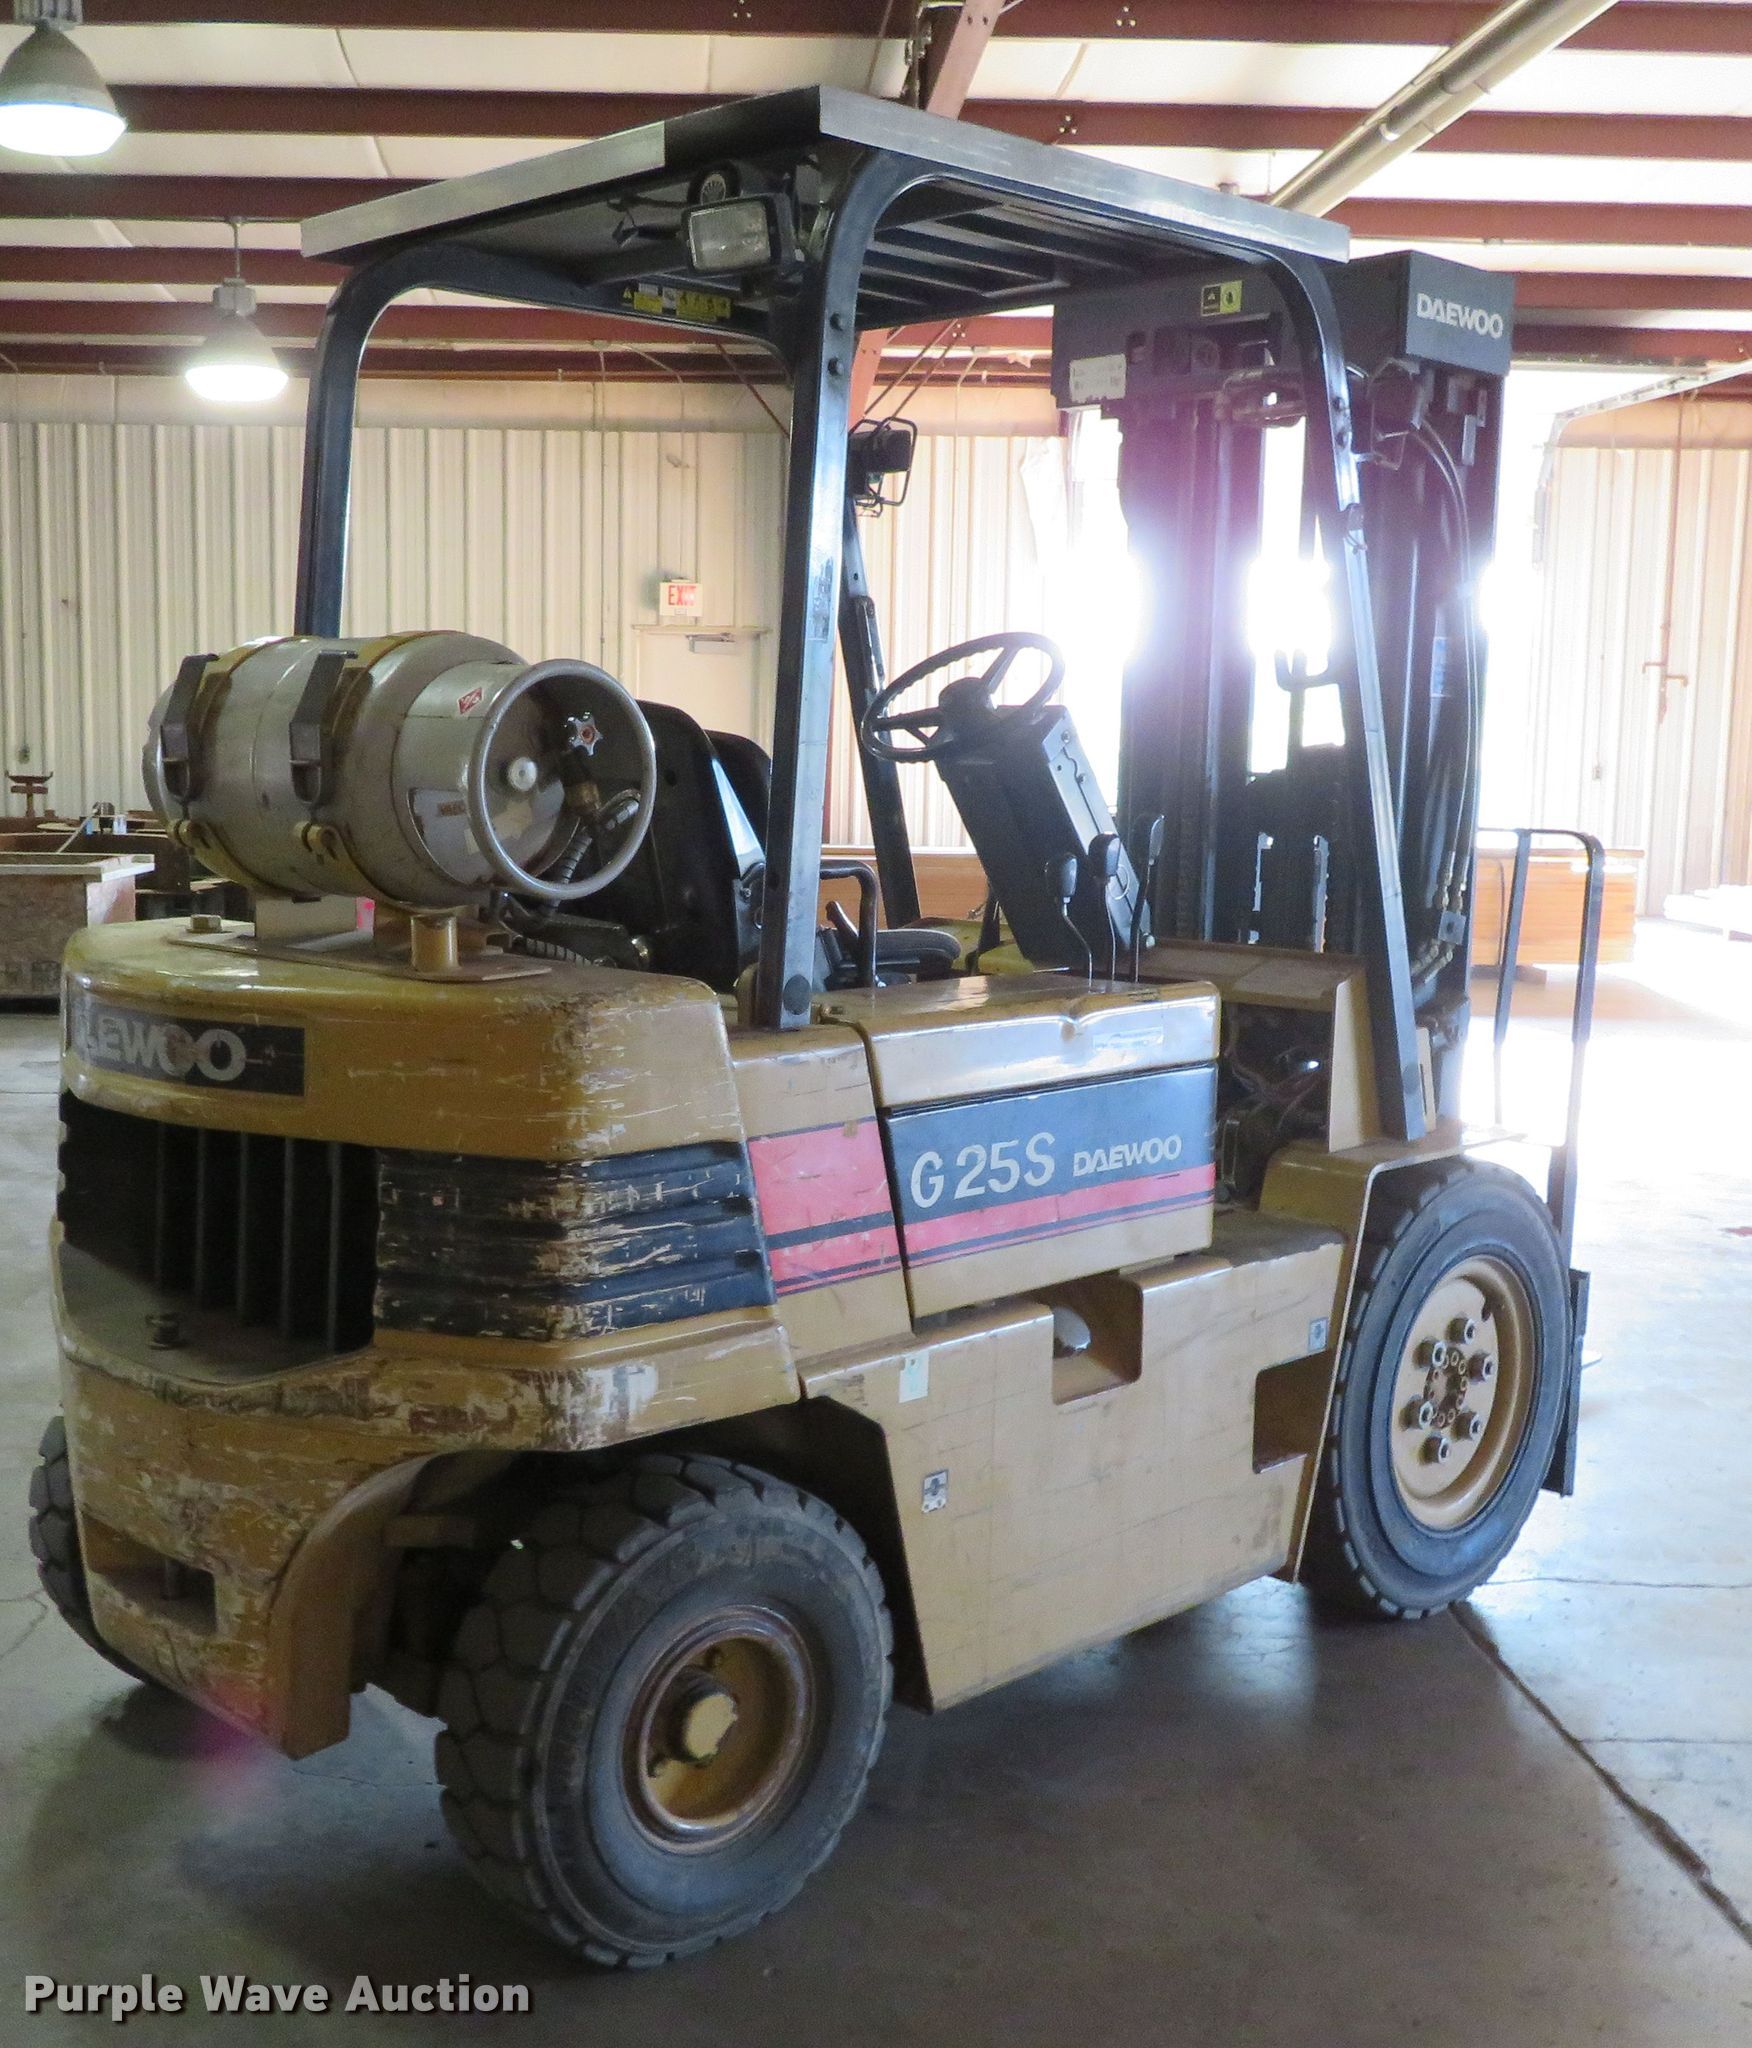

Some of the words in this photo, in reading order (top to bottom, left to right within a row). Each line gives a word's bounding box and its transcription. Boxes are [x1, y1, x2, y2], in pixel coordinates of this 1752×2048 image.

[1417, 293, 1504, 339] DAEWOO
[668, 585, 697, 606] EXIT
[1072, 1134, 1182, 1177] DAEWOO
